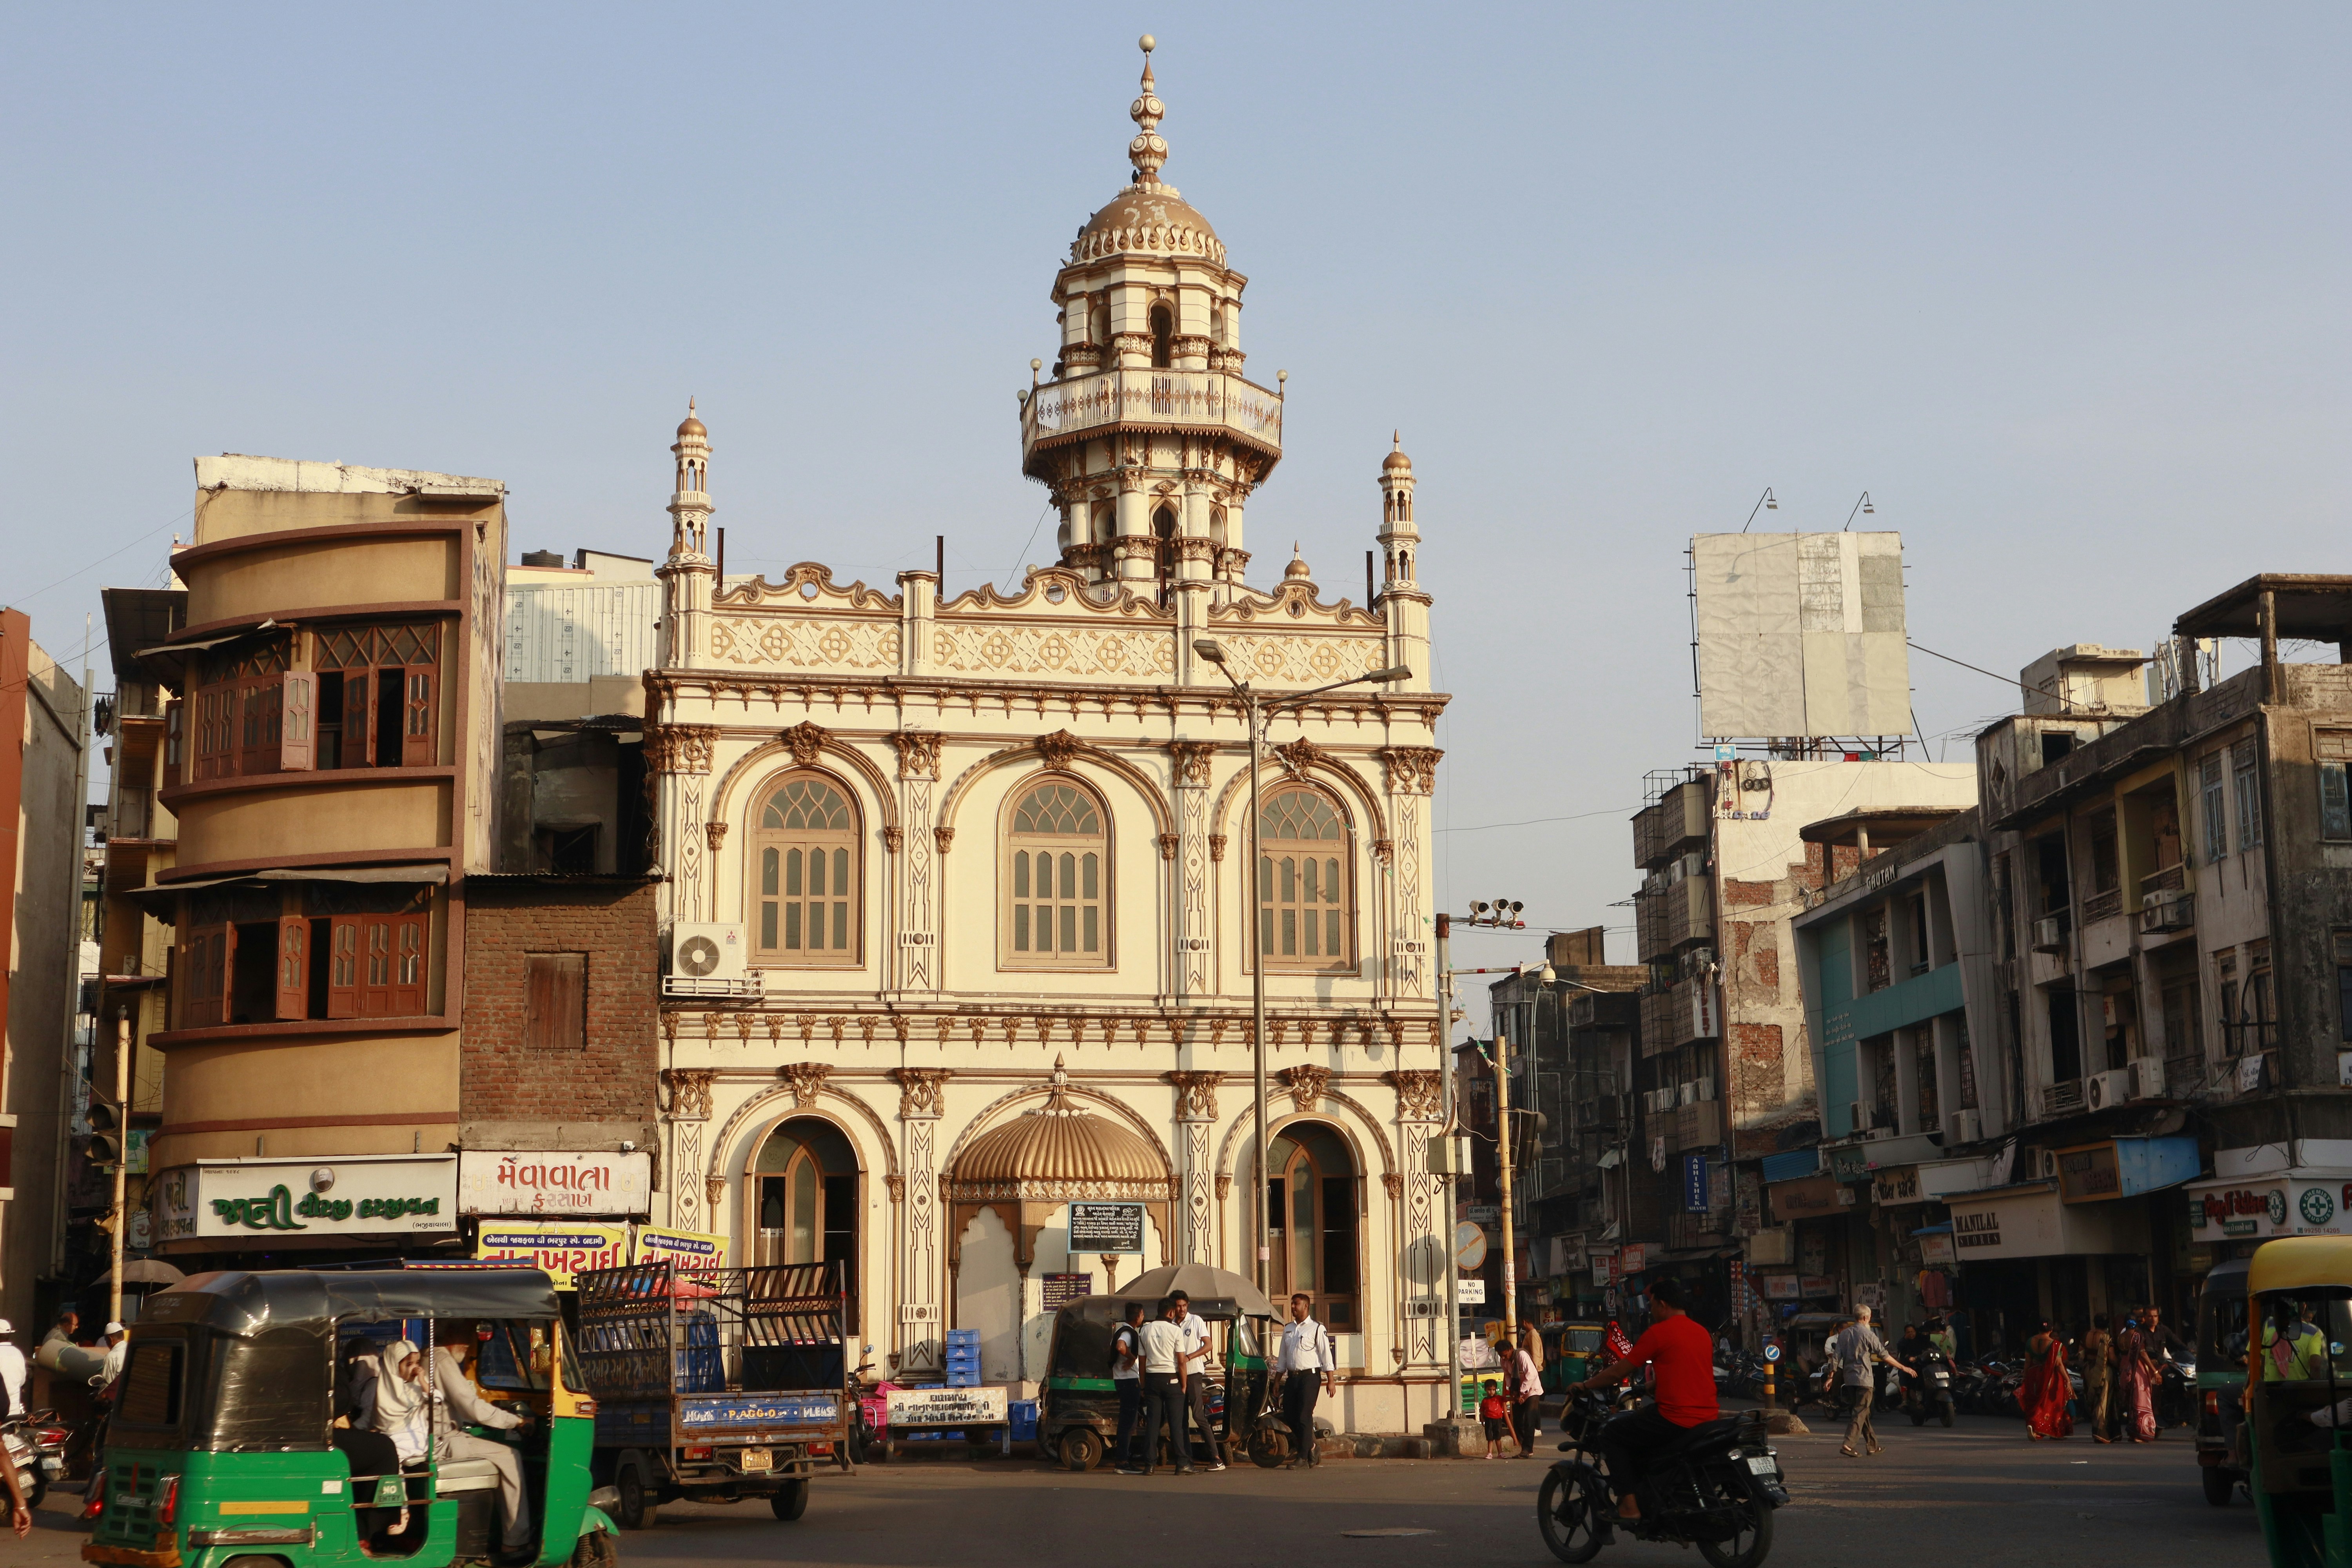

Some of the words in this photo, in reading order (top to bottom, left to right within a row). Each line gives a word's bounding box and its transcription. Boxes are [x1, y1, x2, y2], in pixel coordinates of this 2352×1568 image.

[1866, 864, 1895, 890] GAUTAM
[1692, 1158, 1700, 1206] ABHISHEK
[2305, 1190, 2330, 1200] CHEMIST
[213, 1184, 307, 1229] જાની
[359, 1197, 439, 1220] હરજીવન
[533, 1193, 592, 1211] ફરસાણ
[2305, 1210, 2332, 1222] DRUGGIST
[1955, 1212, 1999, 1233] MANILAL
[486, 1235, 508, 1244] એલચી
[510, 1236, 534, 1245] જાયફળ
[547, 1236, 567, 1247] ભરપુર
[583, 1236, 603, 1245] બદામી
[1960, 1234, 1998, 1246] STORES
[804, 1406, 837, 1417] PLEASE
[383, 1485, 397, 1494] NO
